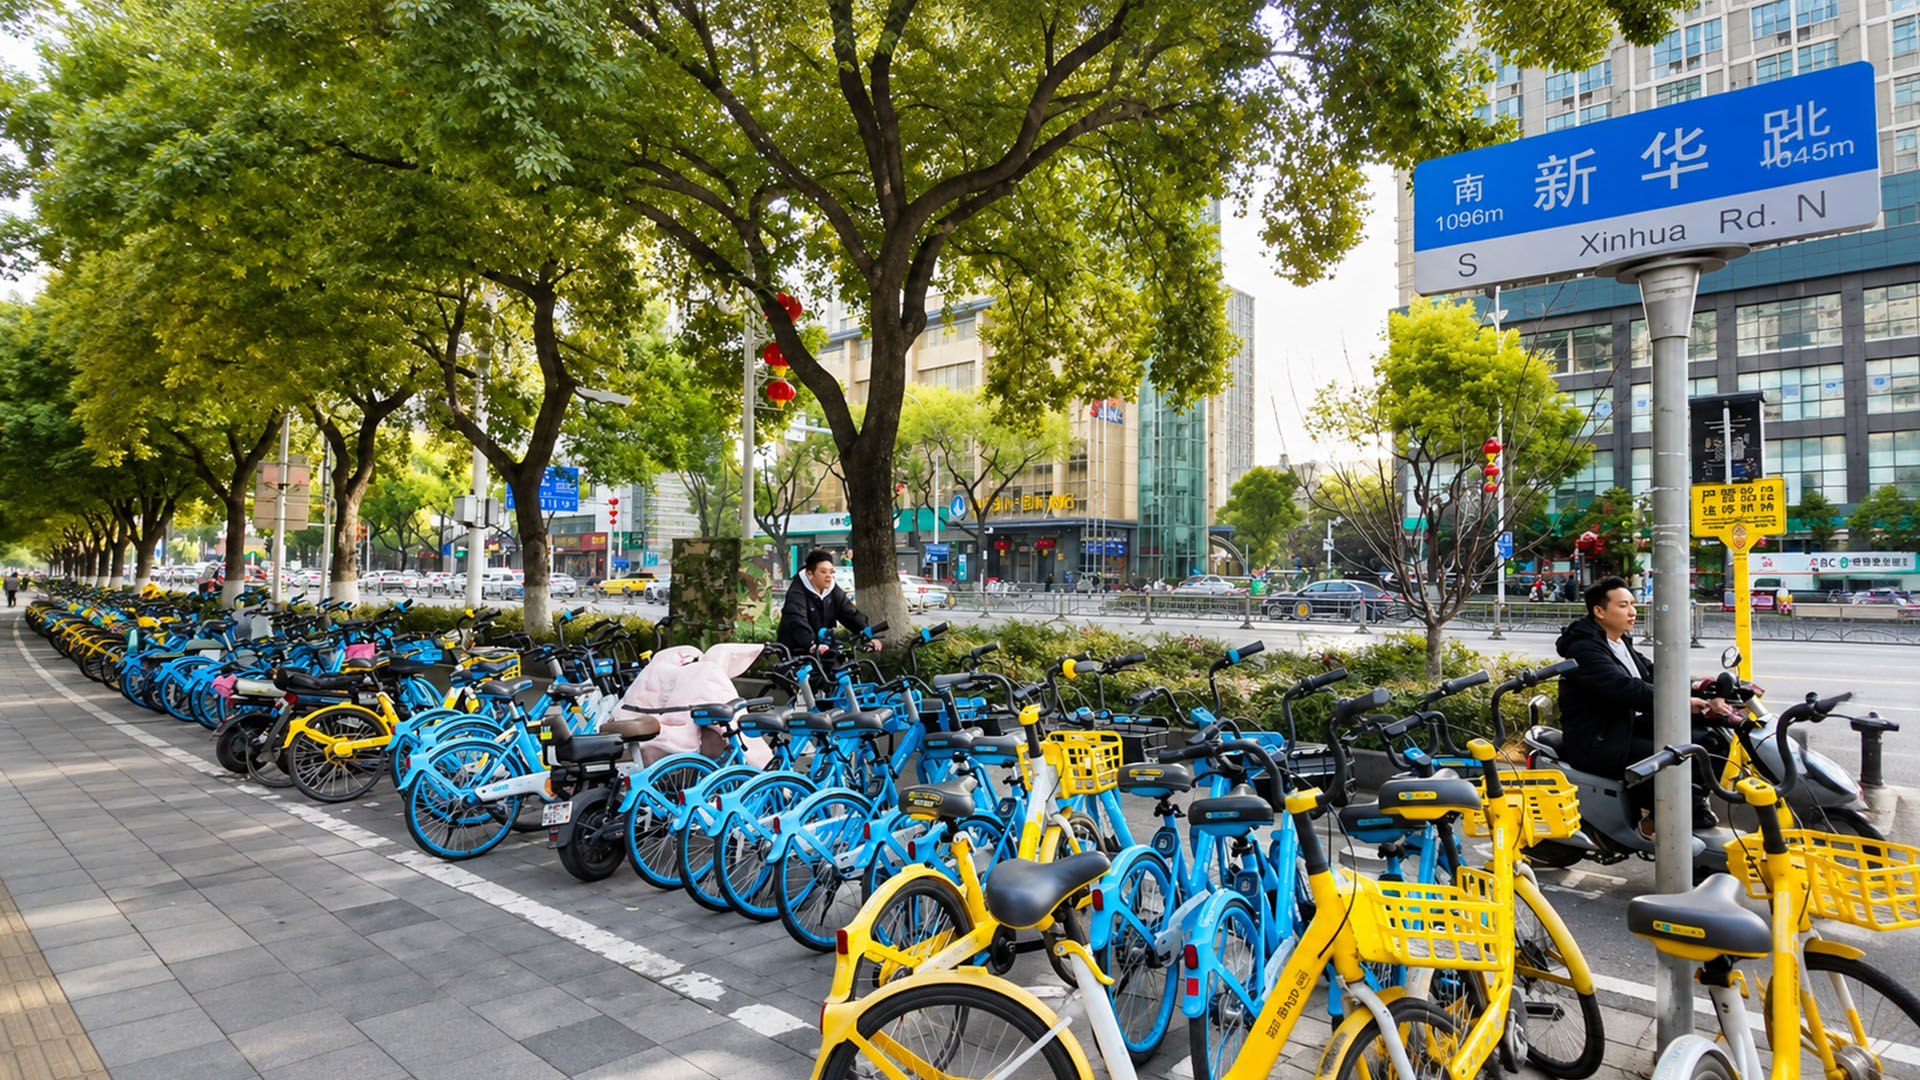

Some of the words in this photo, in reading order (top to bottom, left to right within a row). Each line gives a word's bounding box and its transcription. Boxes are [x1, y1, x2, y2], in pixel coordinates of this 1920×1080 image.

[1453, 173, 1485, 206] 南
[1435, 207, 1504, 232] 1096m
[1458, 252, 1478, 277] S
[1579, 223, 1687, 258] Xinhua
[1719, 204, 1776, 234] Rd.
[1798, 190, 1826, 222] N
